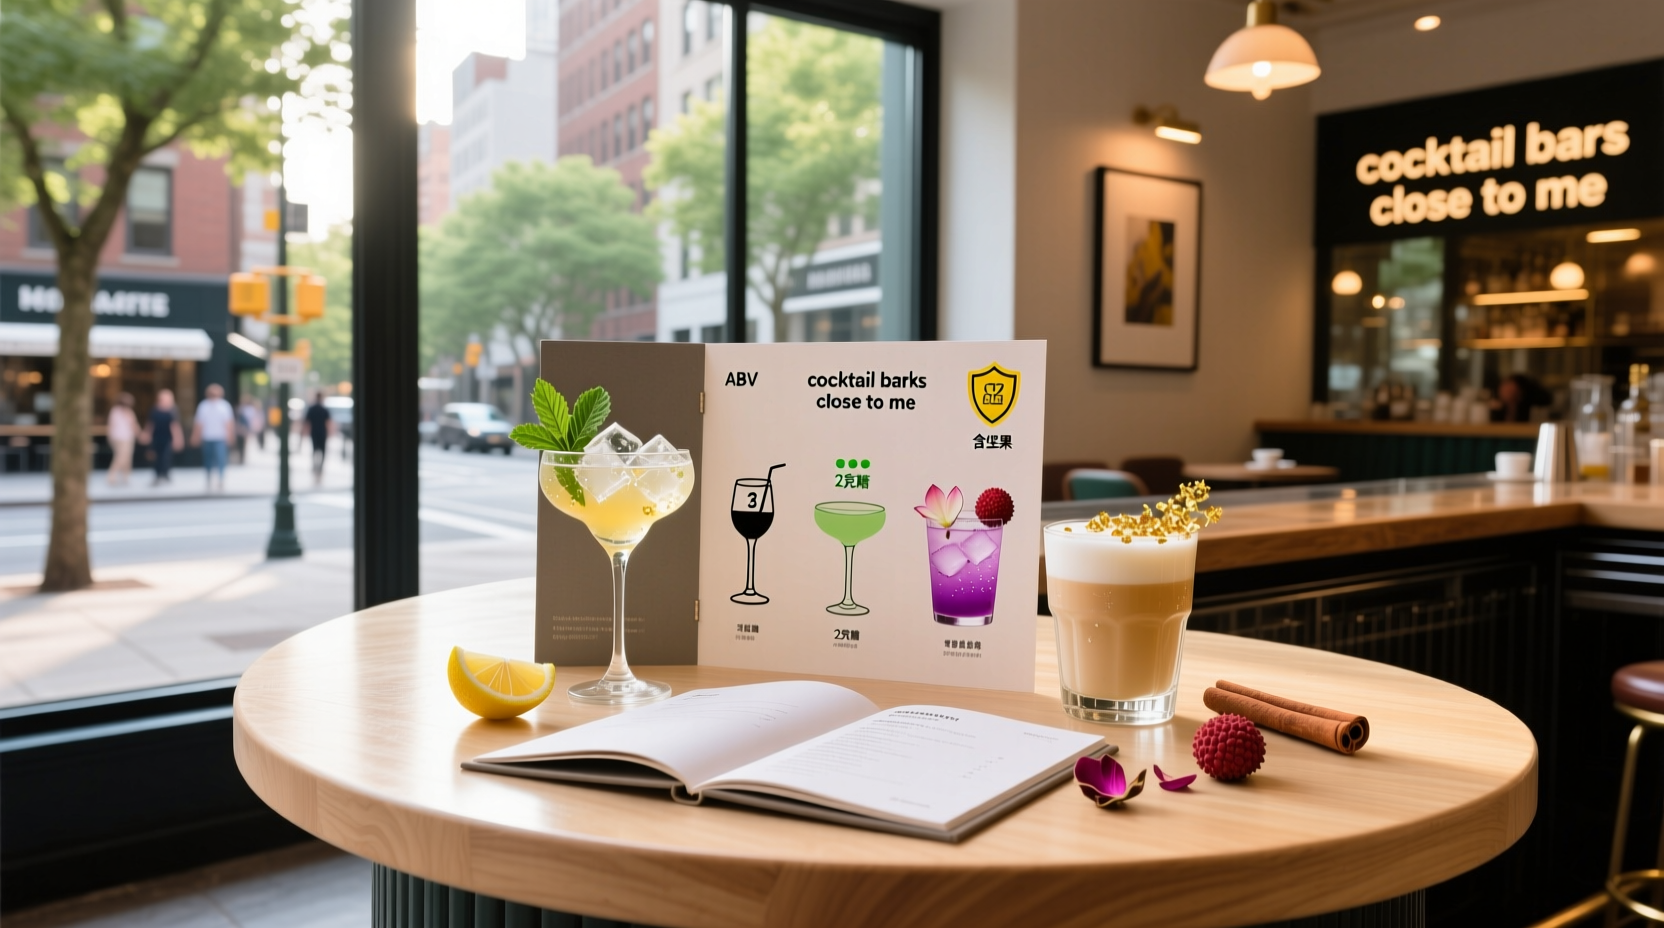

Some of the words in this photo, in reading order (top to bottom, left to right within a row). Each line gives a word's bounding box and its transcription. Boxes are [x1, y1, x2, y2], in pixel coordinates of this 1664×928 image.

[1356, 124, 1516, 185] cocktail
[1525, 120, 1630, 165] bars
[1369, 184, 1473, 226] close
[1480, 177, 1527, 216] to
[1535, 172, 1608, 211] me
[724, 371, 759, 387] ABV
[807, 371, 876, 388] cocktail
[880, 371, 927, 389] barks
[816, 393, 862, 410] close
[865, 395, 884, 410] to
[889, 397, 916, 411] me
[747, 492, 758, 509] 3
